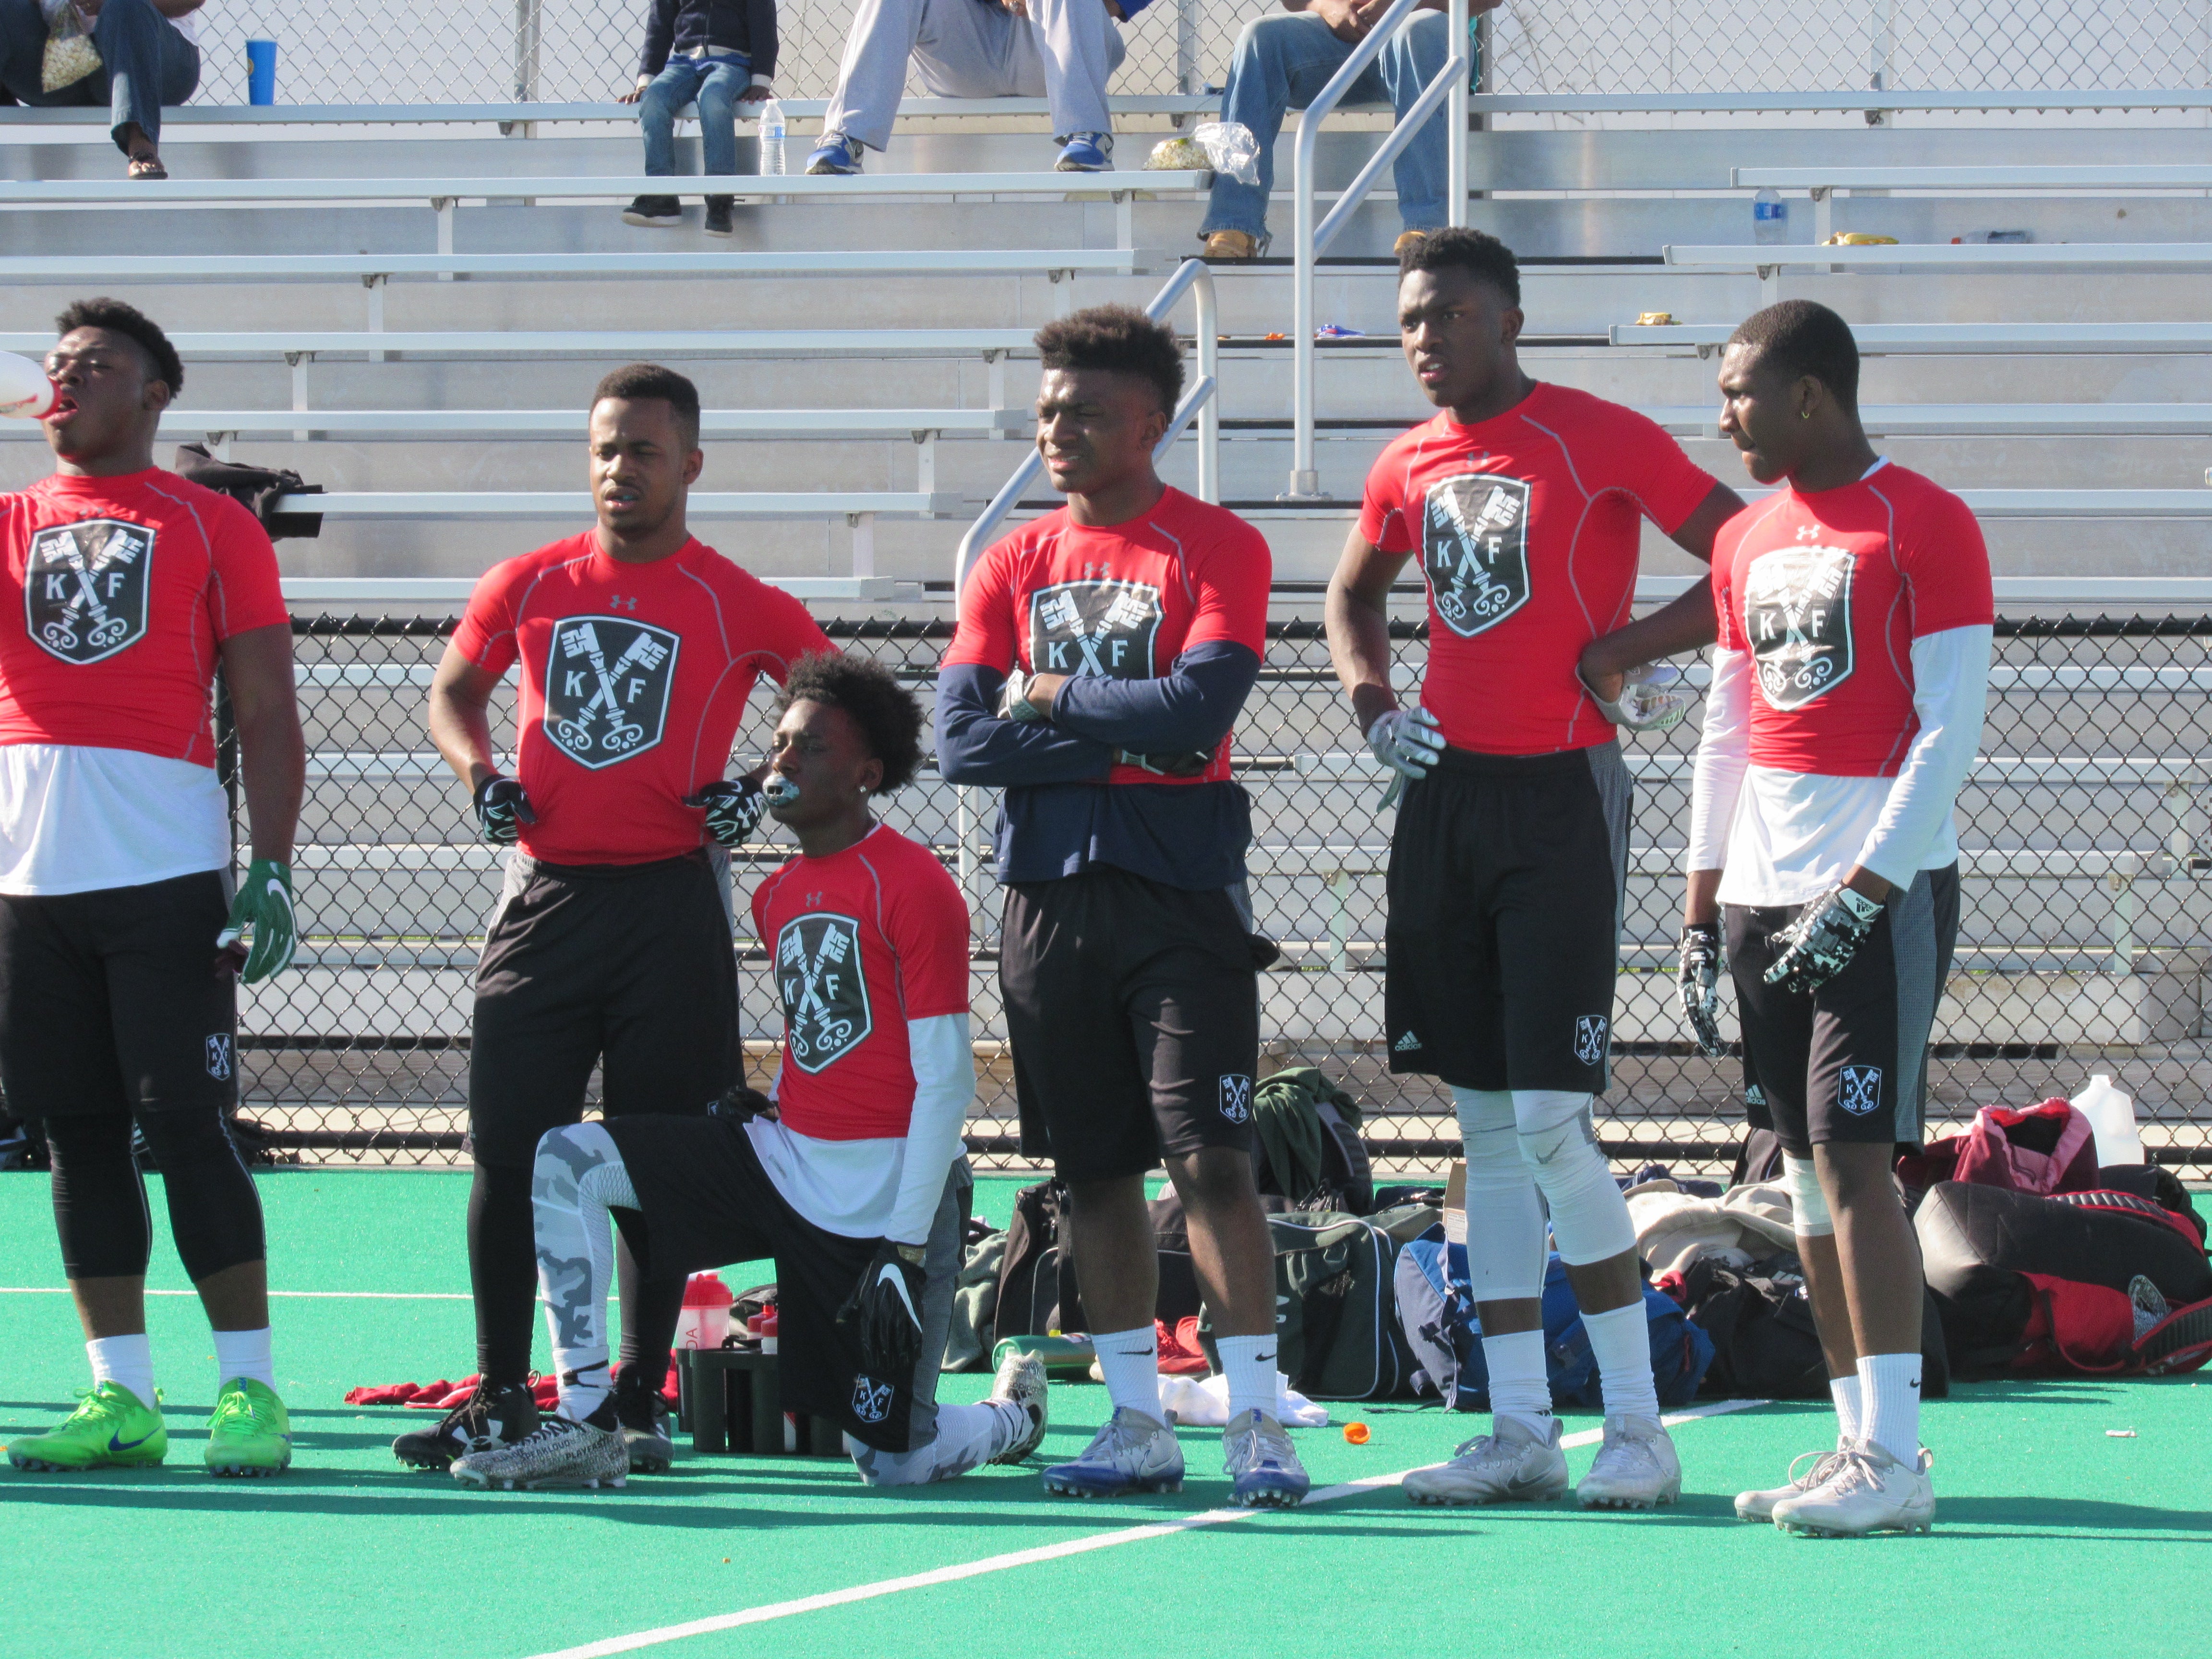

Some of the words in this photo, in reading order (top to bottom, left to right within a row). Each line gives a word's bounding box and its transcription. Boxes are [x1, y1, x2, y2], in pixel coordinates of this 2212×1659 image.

[1437, 539, 1453, 568] K
[1488, 536, 1503, 564] F
[46, 573, 68, 600] K
[108, 572, 125, 598] F
[1760, 612, 1777, 641] K
[1812, 609, 1826, 638] F
[1048, 641, 1069, 669] K
[1112, 639, 1129, 667] F
[564, 670, 588, 697] K
[627, 677, 647, 703] F
[1855, 897, 1873, 910] adidas
[784, 977, 798, 1005] K
[825, 974, 840, 1000] F
[1395, 1042, 1422, 1051] adidas
[1581, 1034, 1588, 1043] K
[1597, 1034, 1602, 1044] F
[212, 1052, 217, 1061] K
[1846, 1084, 1853, 1094] K
[1867, 1085, 1873, 1094] F
[1226, 1092, 1233, 1102] K
[1242, 1094, 1246, 1103] F
[859, 1390, 866, 1400] K
[878, 1397, 884, 1406] F
